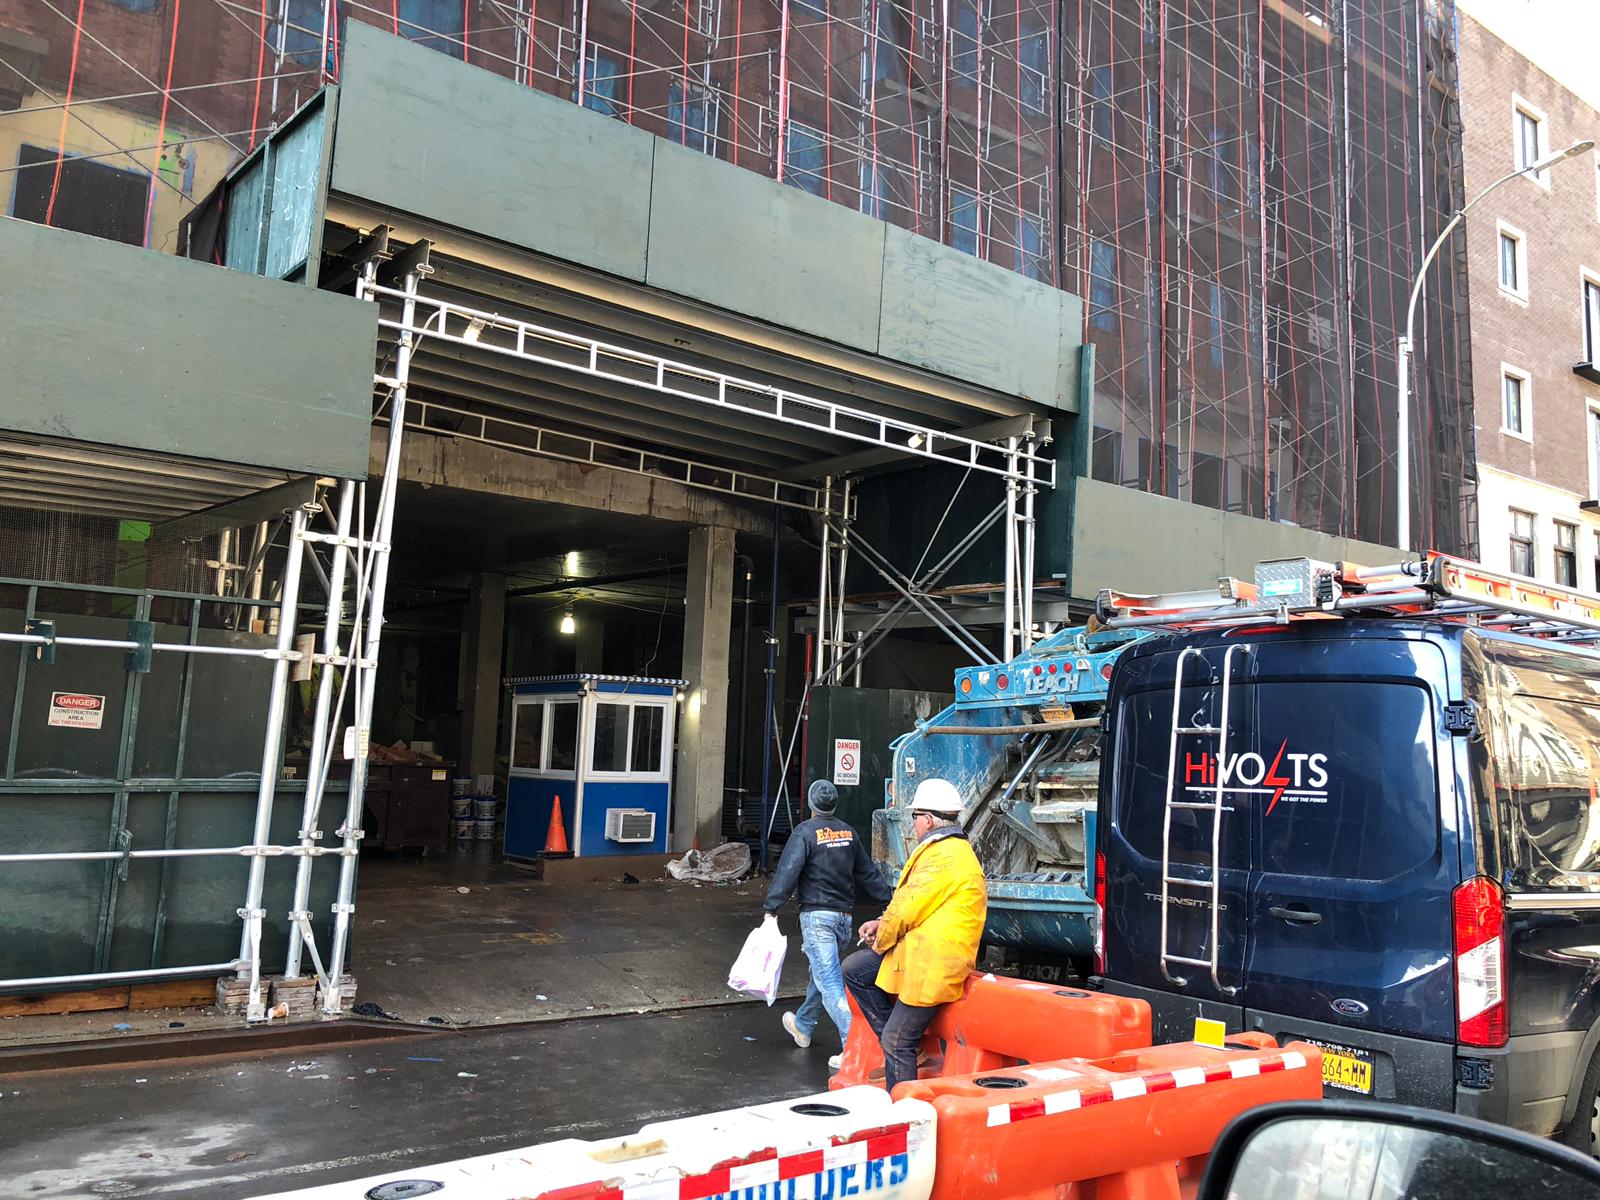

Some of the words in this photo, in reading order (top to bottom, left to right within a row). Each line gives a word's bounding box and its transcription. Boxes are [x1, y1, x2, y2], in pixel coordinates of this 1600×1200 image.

[1025, 673, 1080, 695] LEACH
[60, 698, 97, 706] DANGER
[53, 708, 99, 716] CONSTRUCTION
[837, 741, 859, 750] DANGER
[1320, 1046, 1338, 1056] NEW
[1337, 1049, 1356, 1060] YORK
[1330, 1082, 1369, 1095] CHOICE
[706, 1153, 909, 1200] DERS
